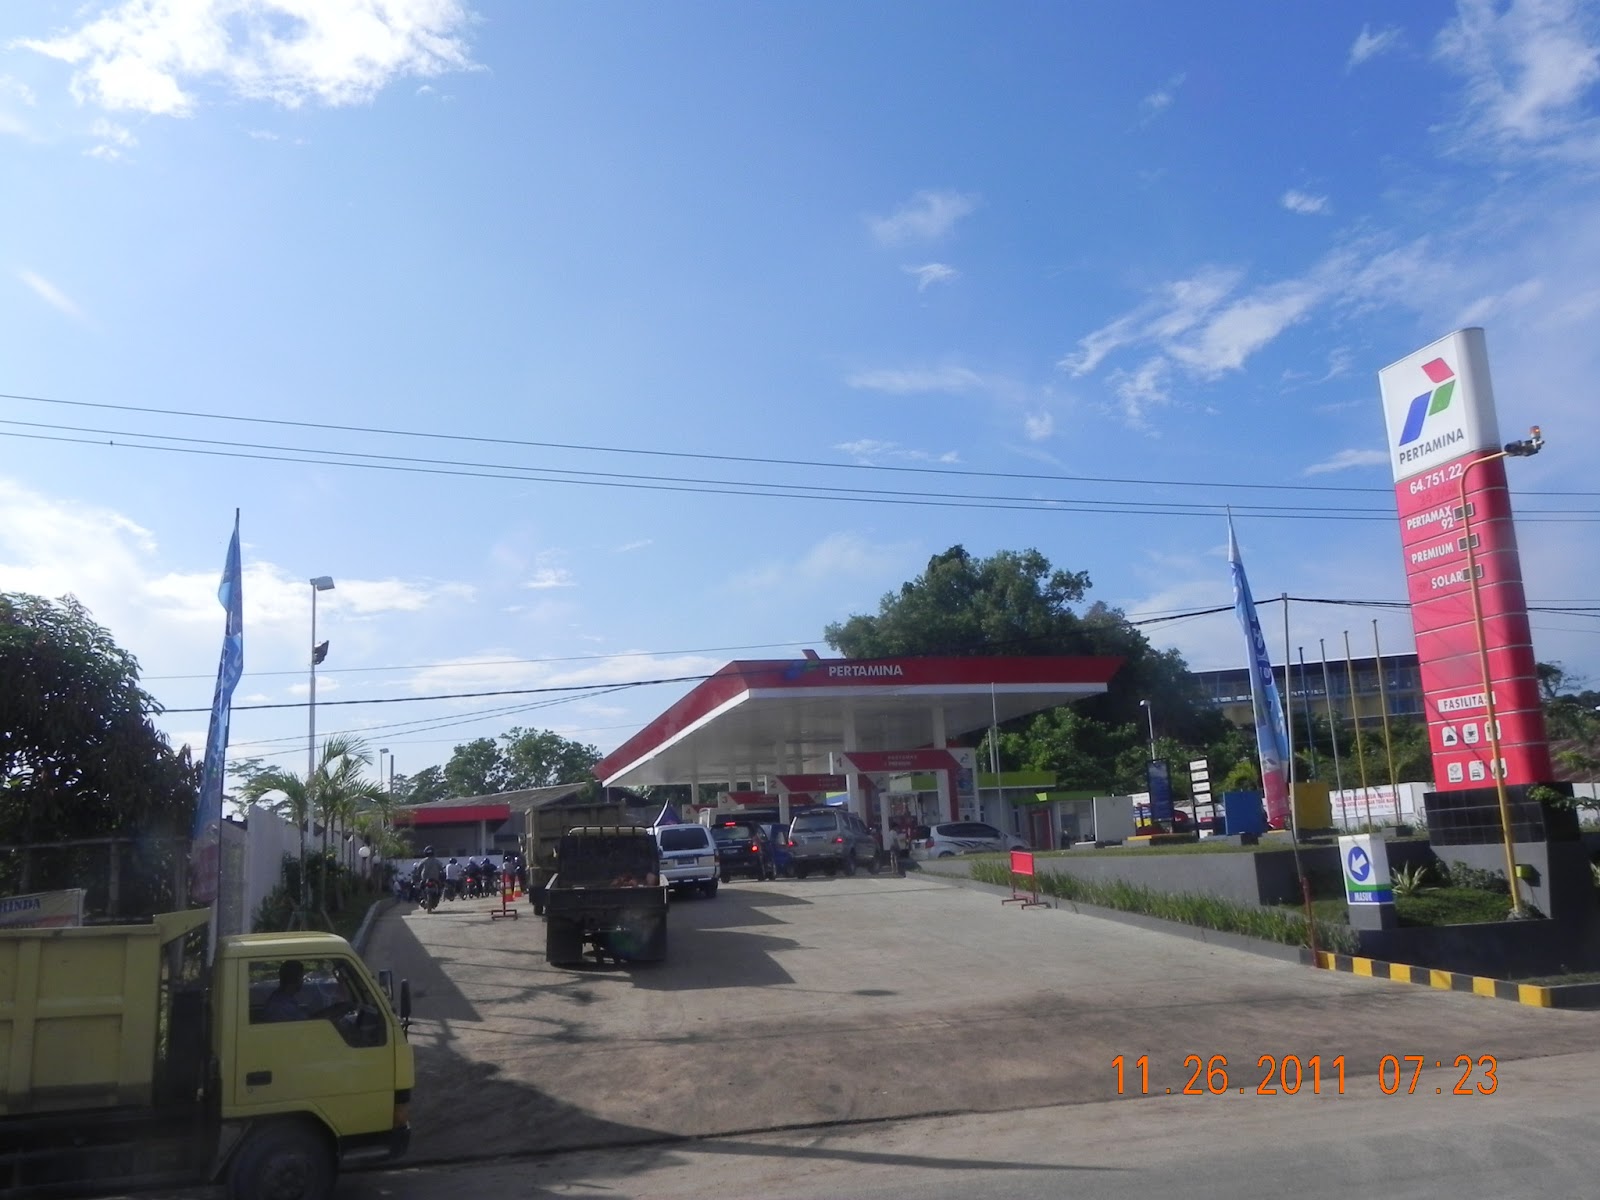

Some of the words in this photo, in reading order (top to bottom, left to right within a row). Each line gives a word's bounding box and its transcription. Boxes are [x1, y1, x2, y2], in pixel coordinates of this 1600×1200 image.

[1399, 428, 1464, 464] PERTAMINA
[1409, 463, 1463, 494] 64.751.22
[1406, 505, 1453, 530] PERTAMAX
[1441, 518, 1454, 530] 92
[1411, 542, 1454, 564] PREMIUM
[1431, 570, 1463, 589] SOLAR
[828, 665, 904, 677] PERTAMINA
